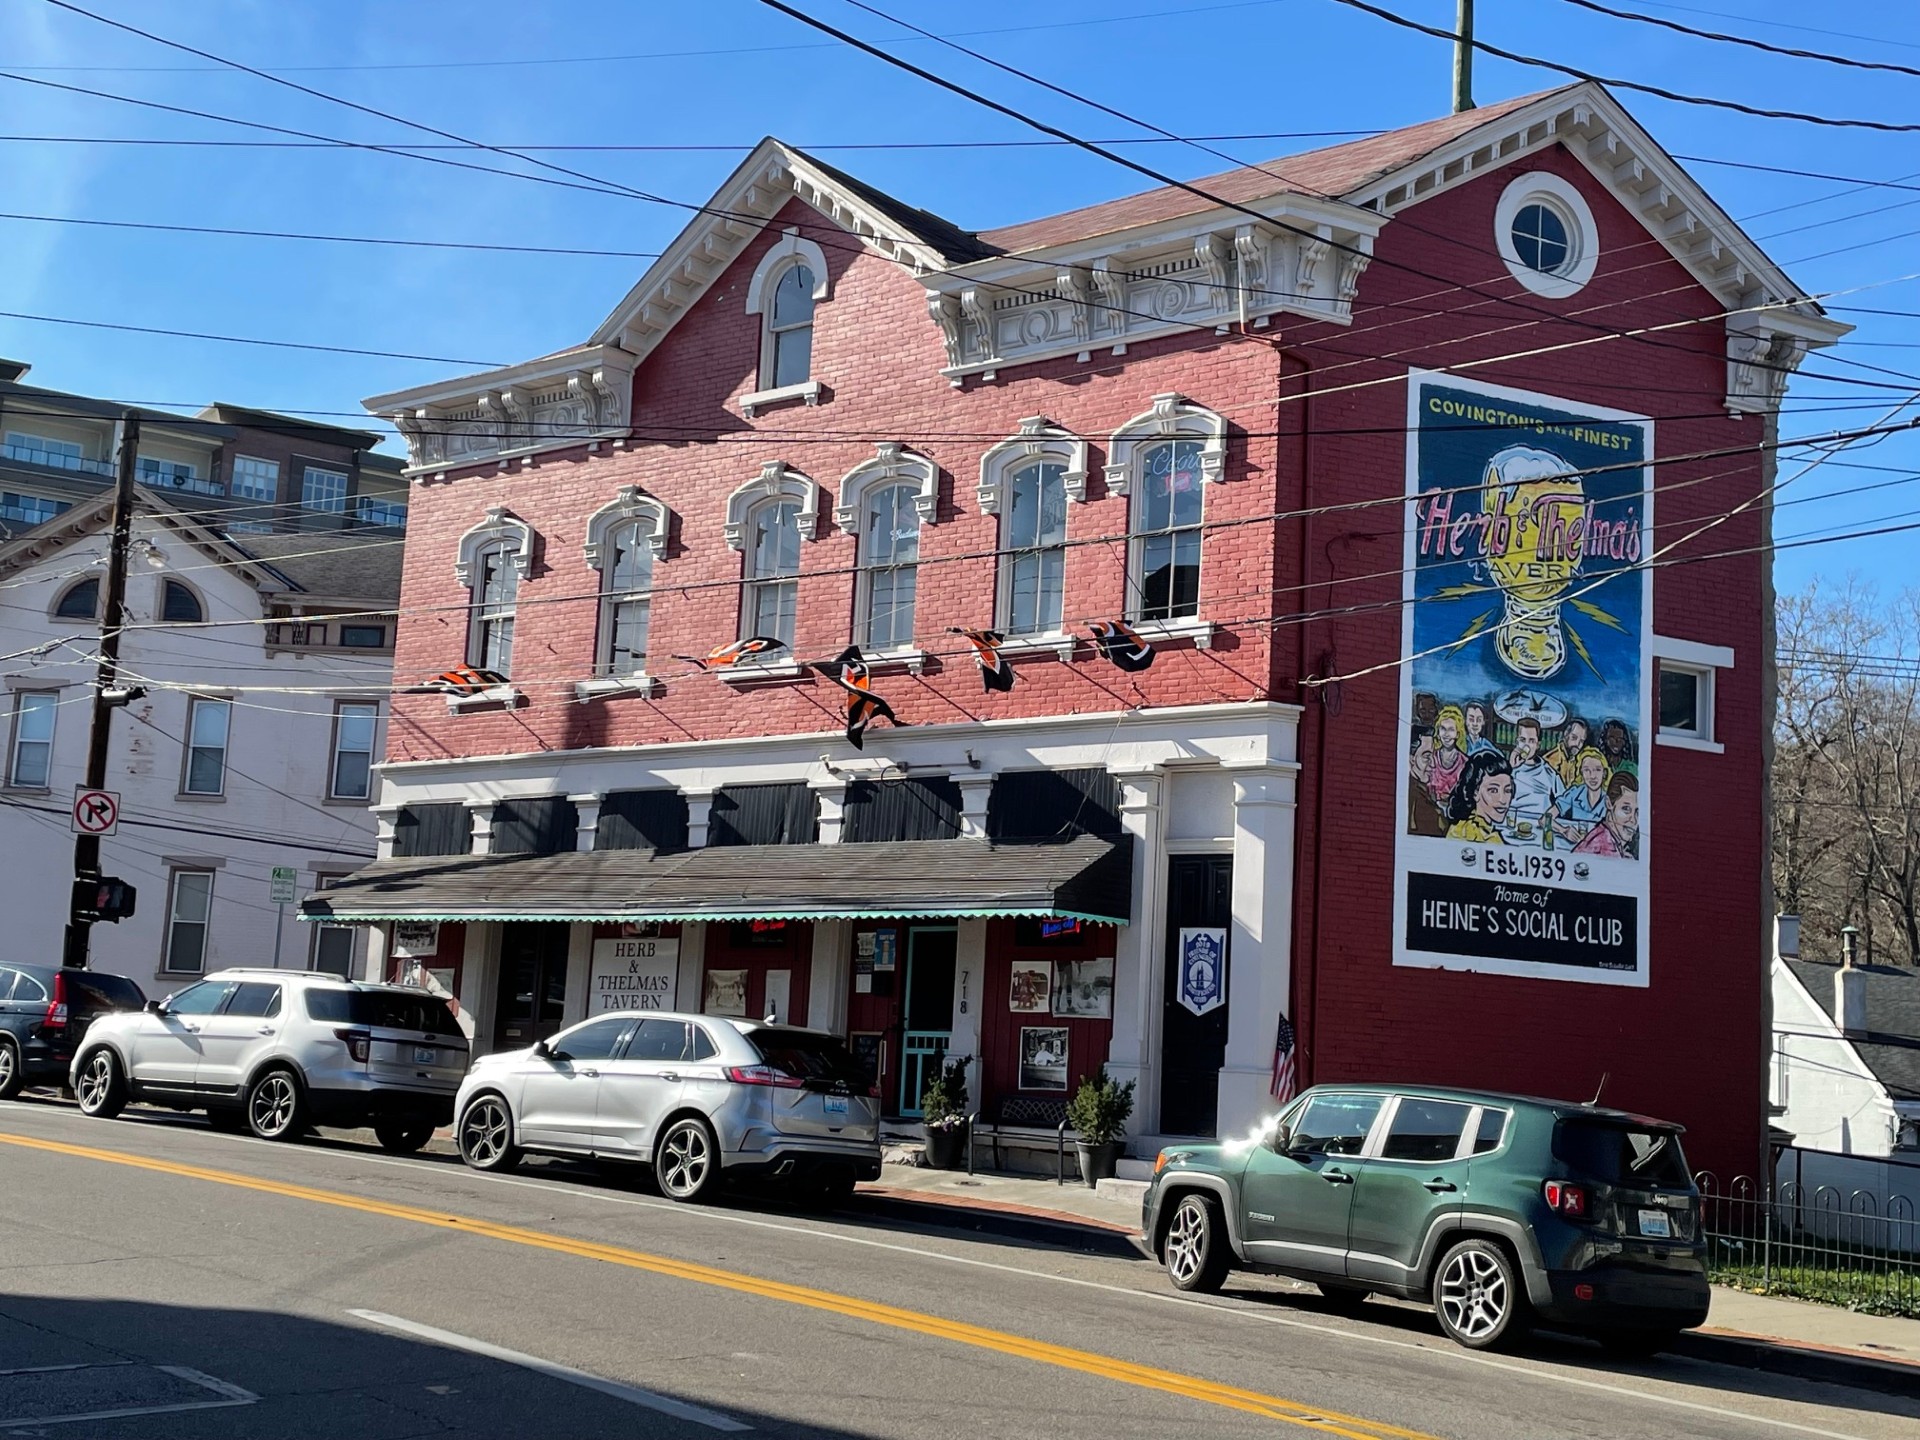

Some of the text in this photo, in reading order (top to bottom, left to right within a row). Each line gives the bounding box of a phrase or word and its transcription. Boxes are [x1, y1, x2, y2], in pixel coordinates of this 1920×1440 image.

[1429, 398, 1632, 450] COVINGTON'S FINEST
[1415, 487, 1511, 558] Herb
[1530, 494, 1641, 562] Thelma's
[1467, 560, 1584, 581] TAVERN
[1494, 885, 1553, 908] Home of
[1422, 899, 1623, 946] HEINE'S SOCIAL CLUB
[615, 942, 656, 957] HERB
[629, 960, 639, 973] &
[598, 975, 669, 991] THELMA'S
[960, 970, 969, 1014] 718
[602, 994, 662, 1009] TAVERN
[1652, 1194, 1668, 1205] Jeep
